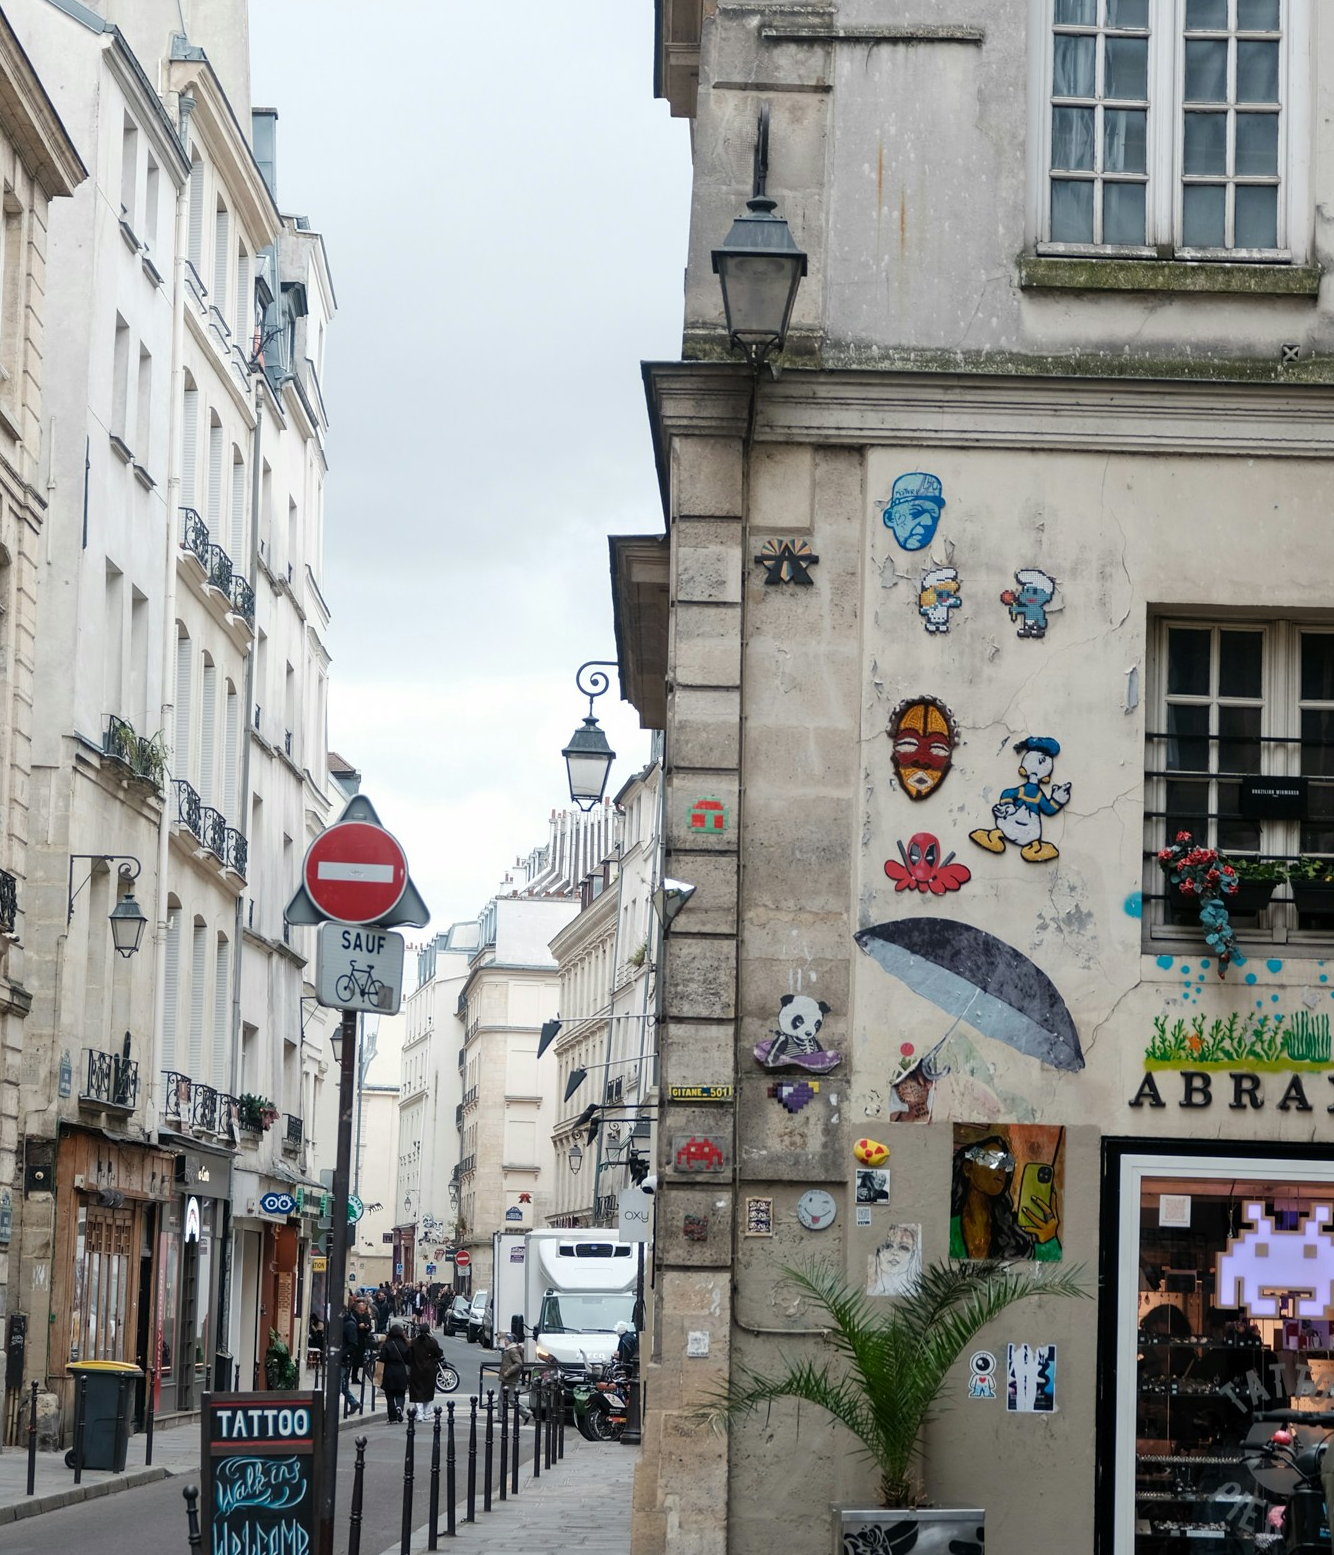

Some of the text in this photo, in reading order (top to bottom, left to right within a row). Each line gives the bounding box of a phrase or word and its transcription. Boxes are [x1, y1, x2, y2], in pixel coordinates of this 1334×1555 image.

[341, 930, 386, 955] SAUF
[710, 1087, 728, 1097] 501
[624, 1210, 650, 1223] oxy
[216, 1407, 311, 1438] TATTOO
